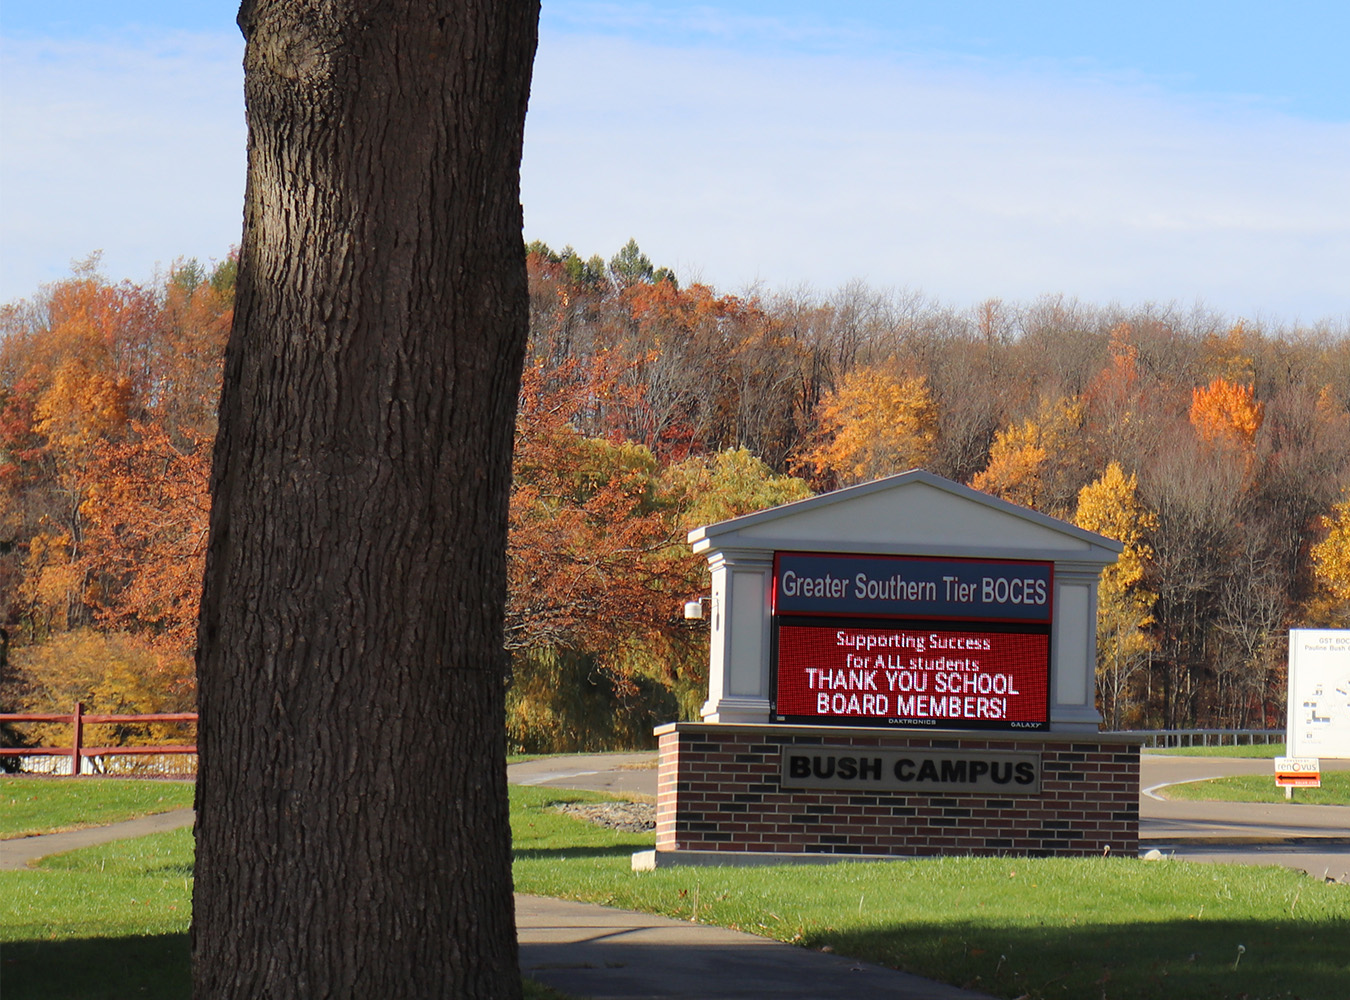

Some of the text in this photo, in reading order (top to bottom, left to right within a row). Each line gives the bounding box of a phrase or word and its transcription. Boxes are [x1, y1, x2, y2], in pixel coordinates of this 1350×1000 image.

[782, 570, 1046, 604] Greater Southern Tier BOCES
[836, 631, 991, 652] Supporting Success
[846, 653, 980, 671] for ALL students
[805, 667, 1019, 695] THANK YOU SCHOOL
[817, 692, 1007, 719] BOARD MEMBERS!
[789, 756, 1035, 785] BUSH CAMPUS
